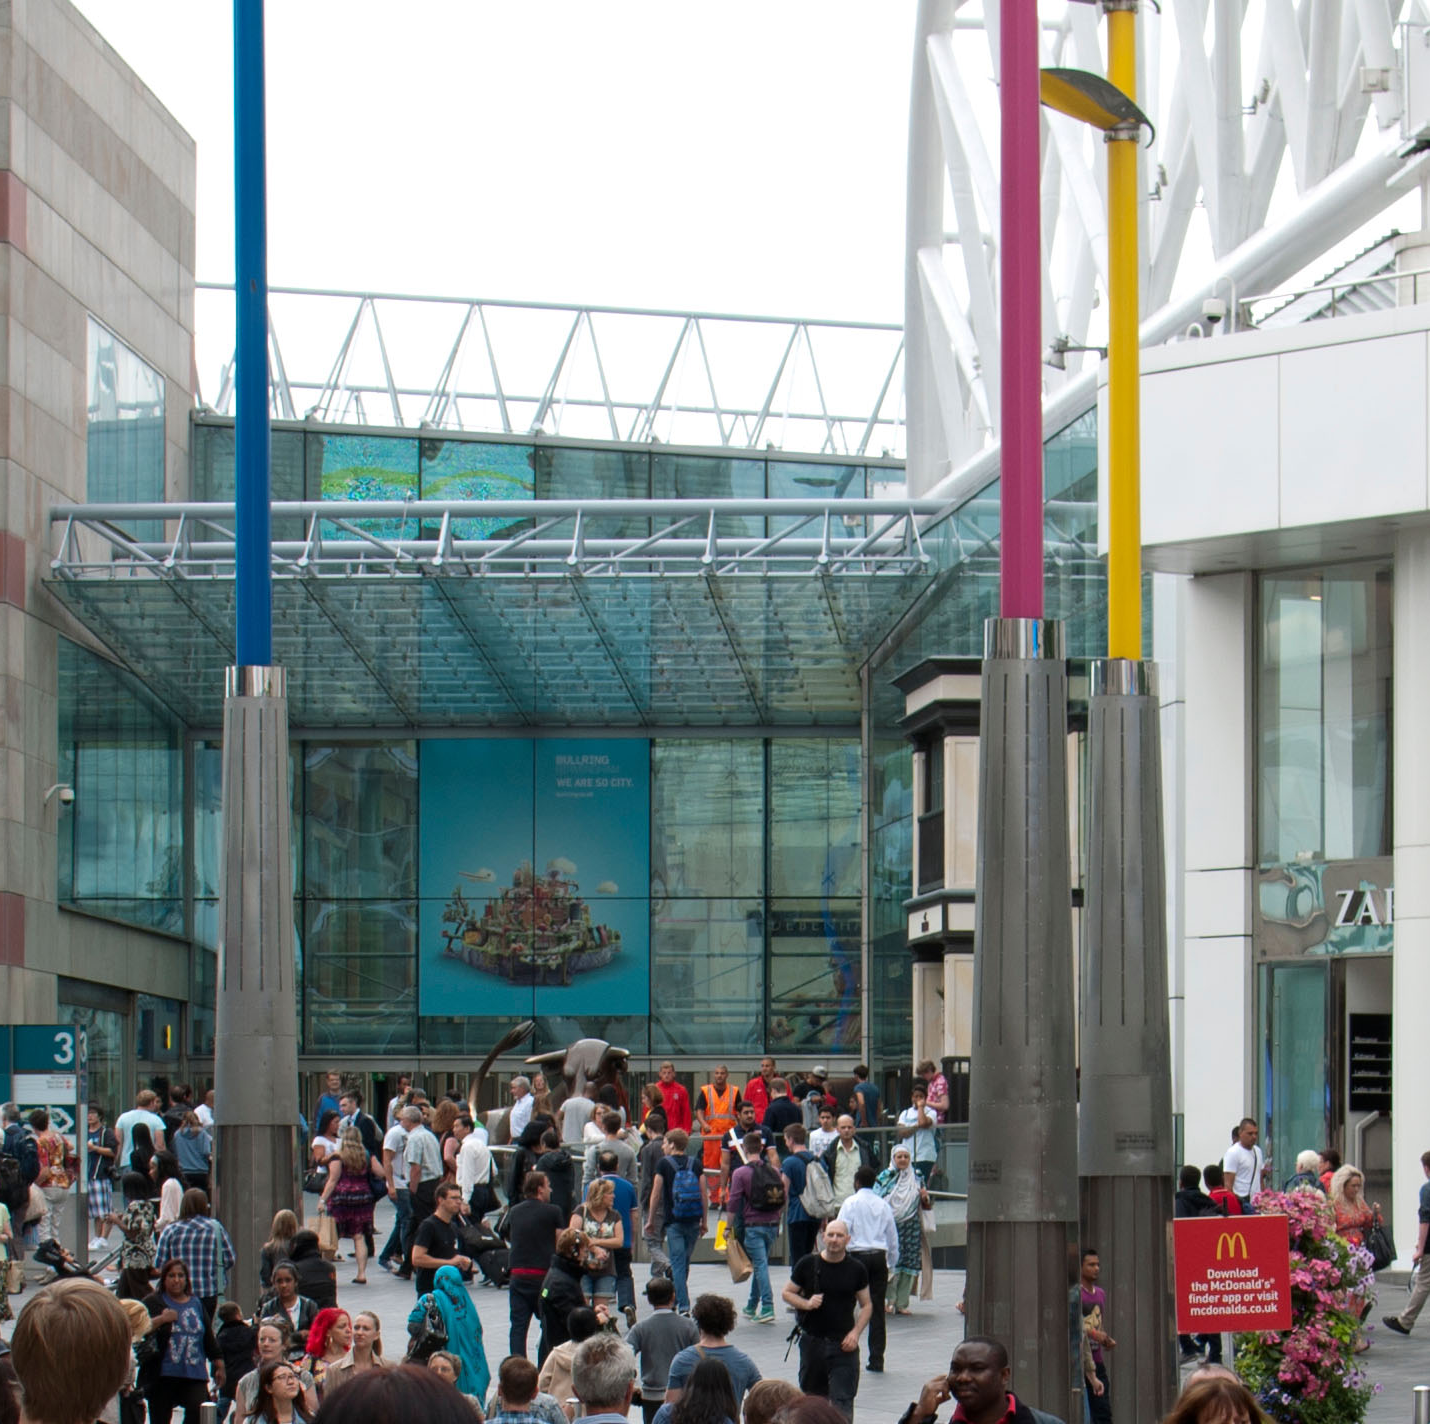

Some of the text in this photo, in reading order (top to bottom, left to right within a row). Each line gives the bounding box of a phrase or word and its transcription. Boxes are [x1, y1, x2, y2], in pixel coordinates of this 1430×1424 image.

[54, 1031, 74, 1064] 3
[79, 1031, 87, 1063] 3
[1207, 1267, 1259, 1279] Download
[1191, 1282, 1208, 1292] the
[1188, 1291, 1279, 1304] finder app or visit
[1190, 1303, 1278, 1316] mcdonalds.co.uk
